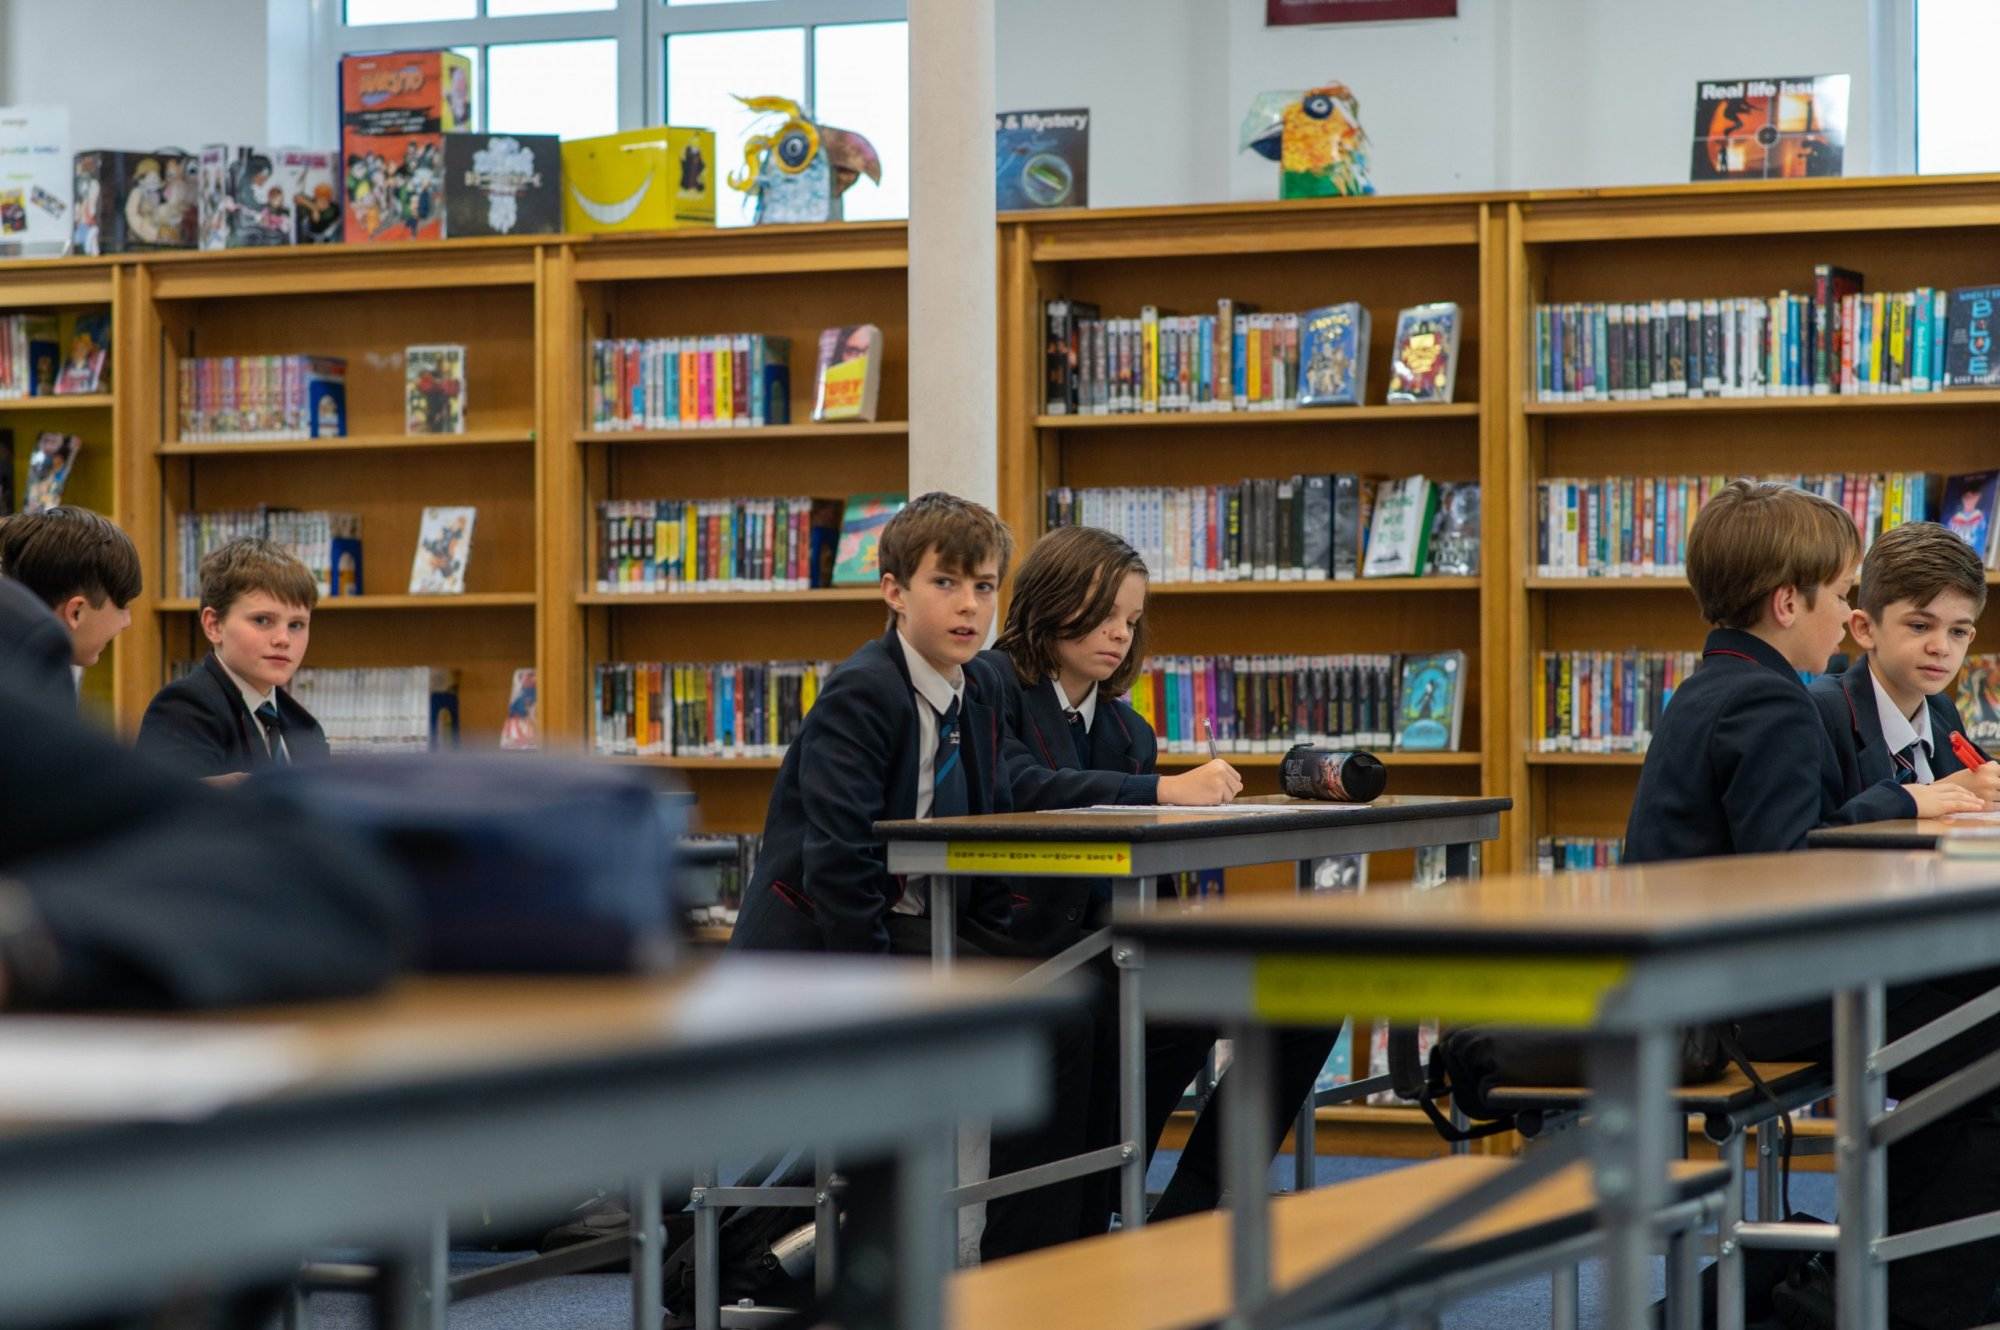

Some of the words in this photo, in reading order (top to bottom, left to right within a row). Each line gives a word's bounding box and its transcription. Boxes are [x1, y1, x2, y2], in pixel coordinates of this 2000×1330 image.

[1702, 83, 1744, 99] Real
[1747, 81, 1776, 96] life
[1005, 115, 1019, 130] &
[1022, 113, 1088, 132] Mystery
[1968, 299, 1992, 376] BLUE
